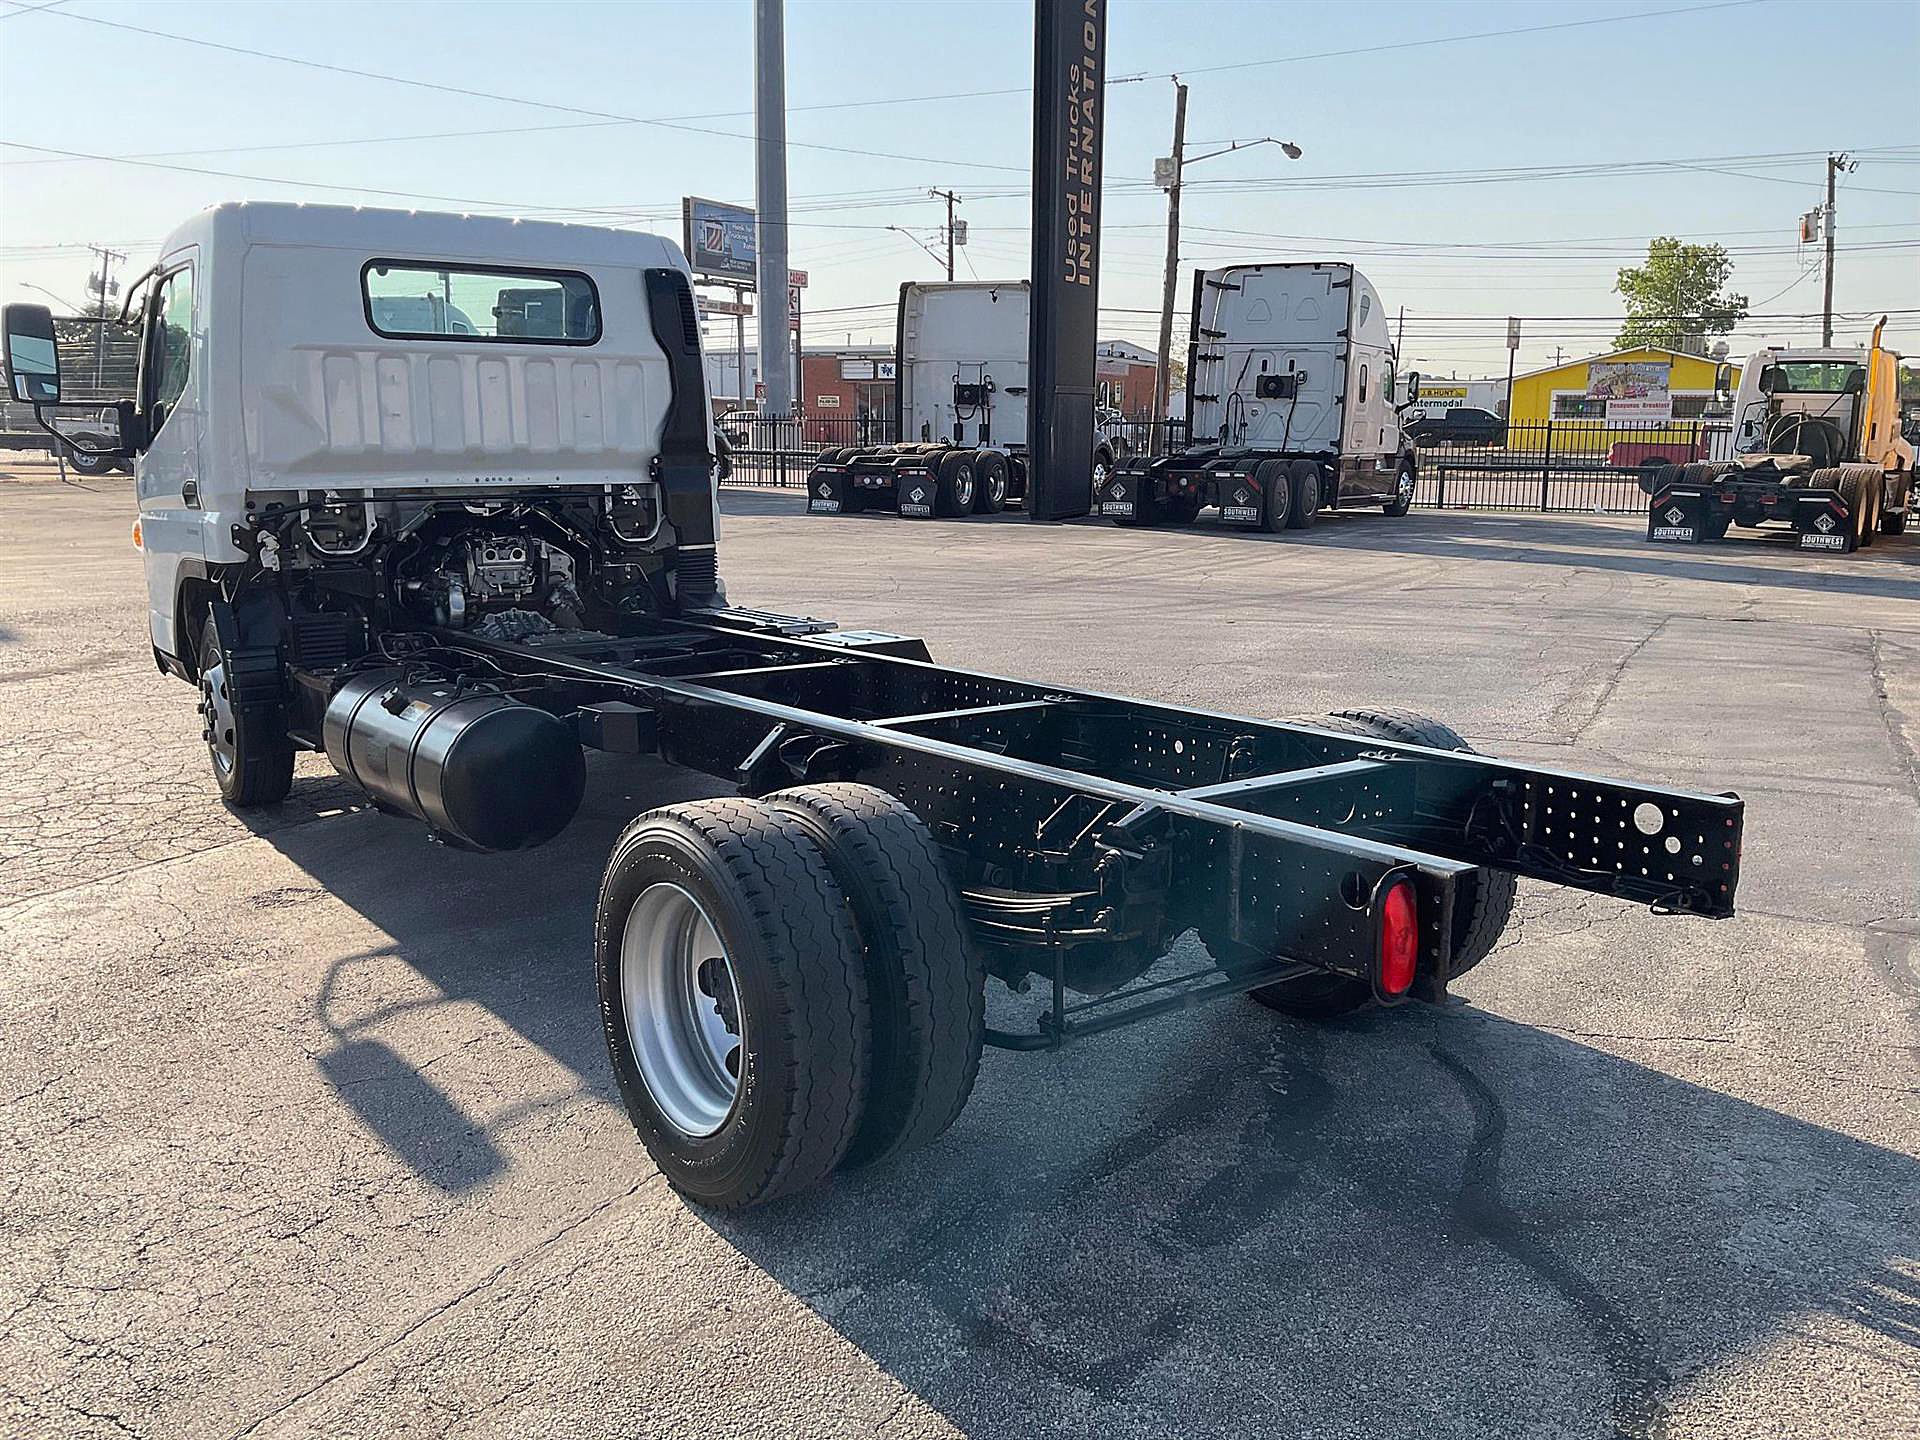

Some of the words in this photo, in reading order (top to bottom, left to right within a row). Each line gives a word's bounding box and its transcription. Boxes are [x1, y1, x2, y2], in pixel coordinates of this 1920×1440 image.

[1066, 63, 1080, 180] Trucks
[1064, 193, 1078, 282] Used
[1653, 528, 1693, 537] SOUTHWEST
[1802, 535, 1844, 545] SOUTHWEST
